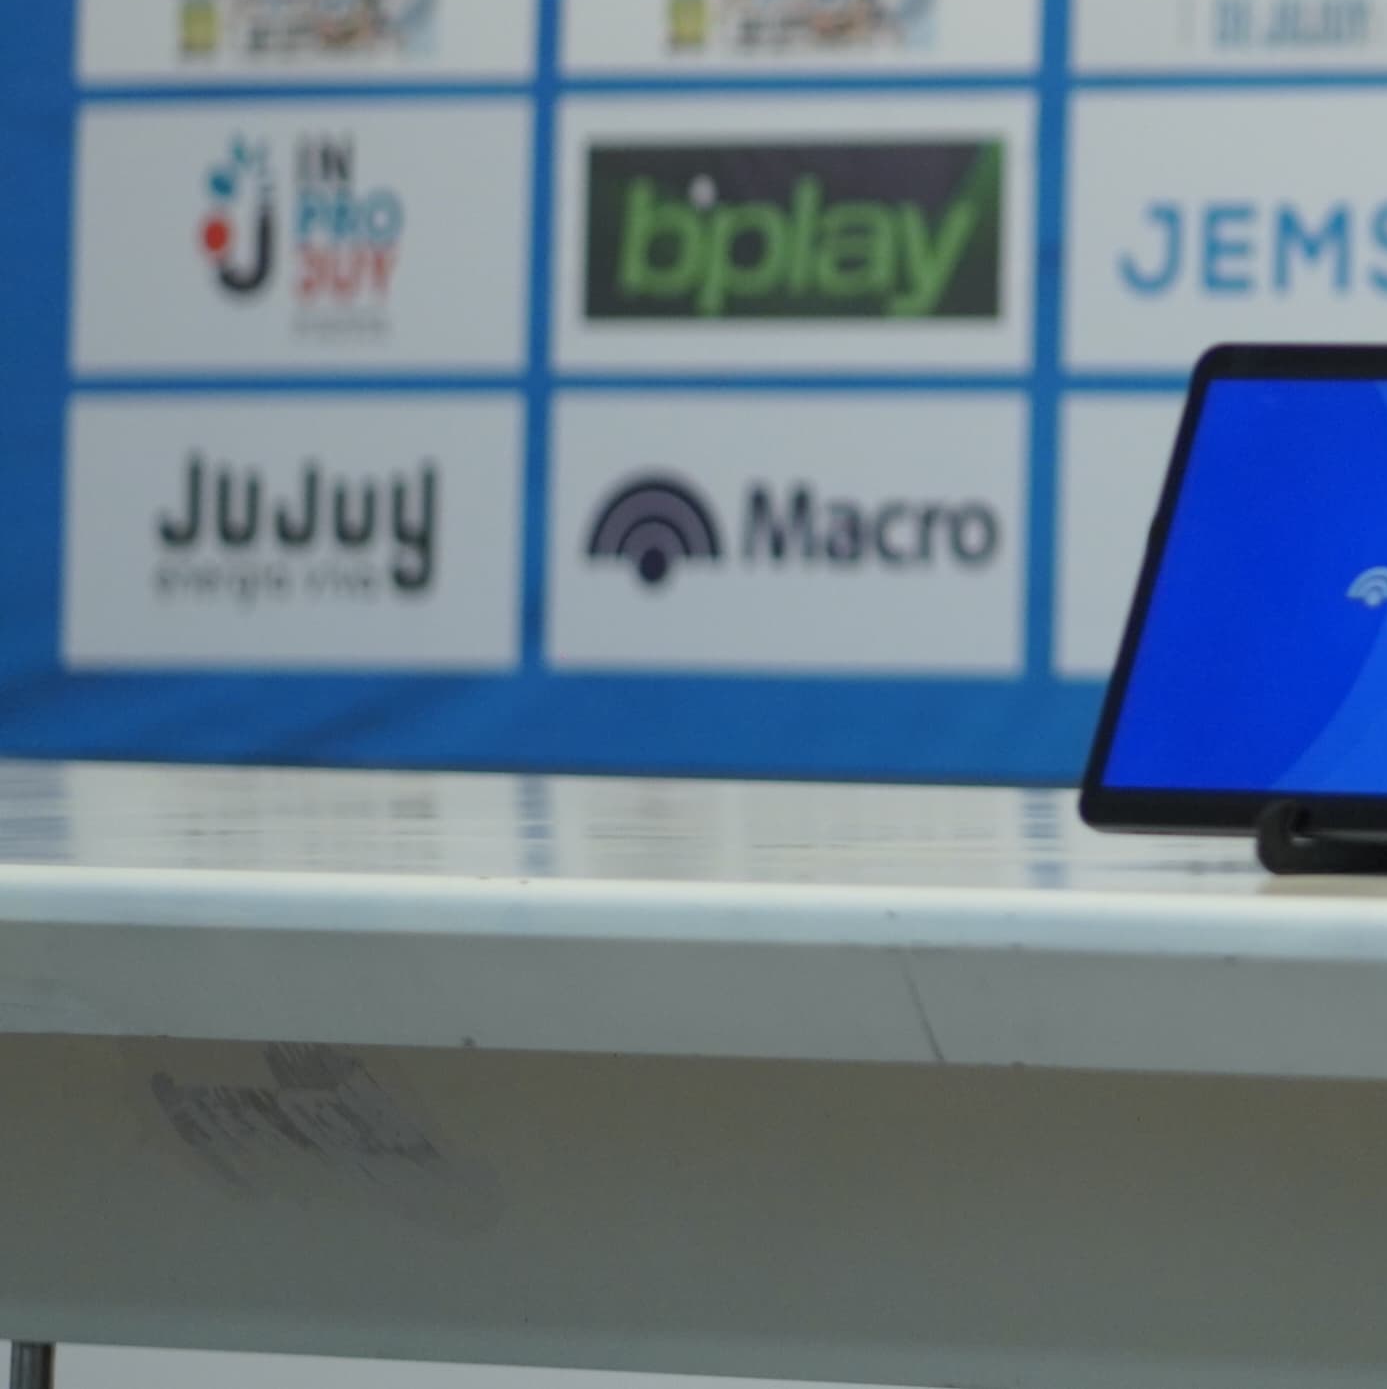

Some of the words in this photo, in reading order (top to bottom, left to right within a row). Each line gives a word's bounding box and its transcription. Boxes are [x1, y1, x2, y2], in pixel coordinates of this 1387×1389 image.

[296, 135, 354, 184] IN
[617, 173, 985, 319] bplay
[740, 481, 1001, 569] Macro
